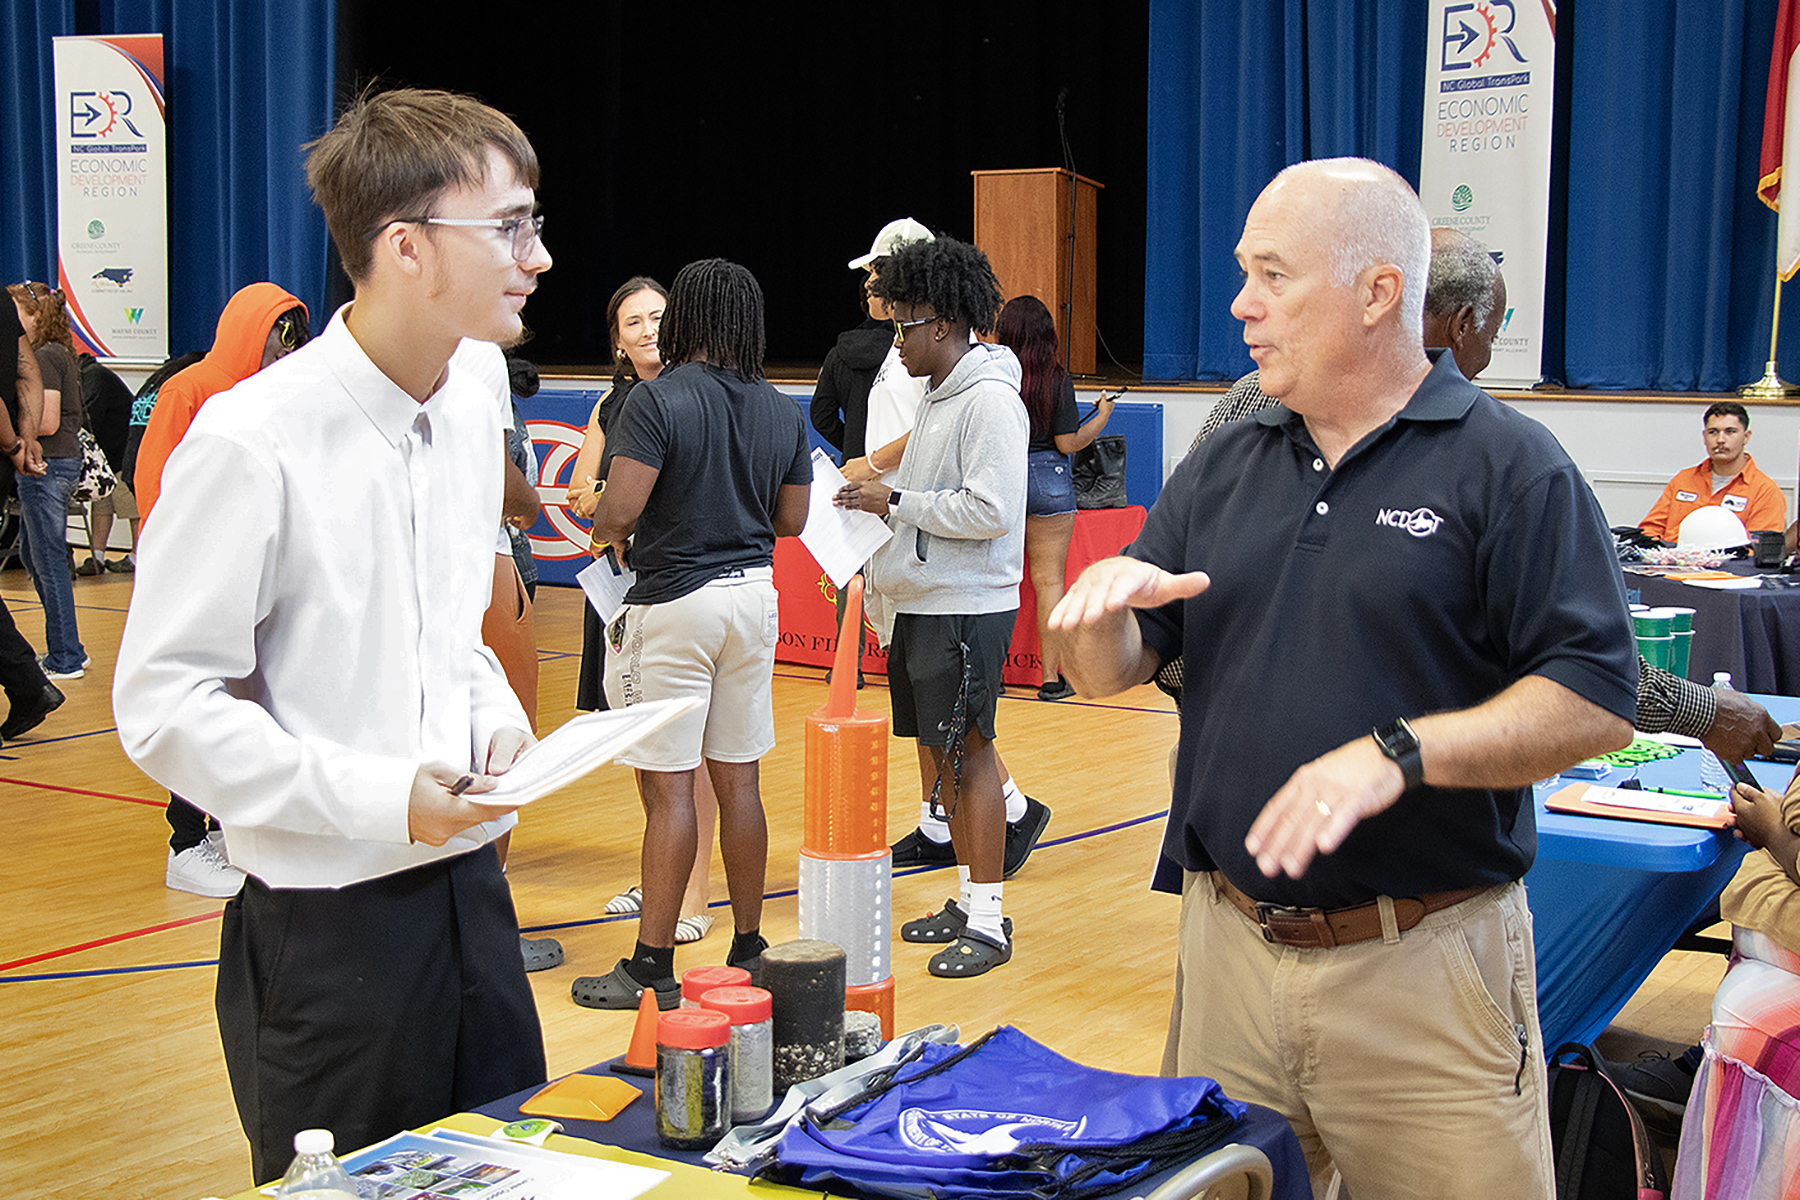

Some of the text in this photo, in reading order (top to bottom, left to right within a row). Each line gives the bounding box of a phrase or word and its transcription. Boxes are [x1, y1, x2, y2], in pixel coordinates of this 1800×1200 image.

[1443, 73, 1529, 92] NC Global TransPark
[1438, 93, 1529, 121] ECONOMIC
[1437, 116, 1528, 138] DEVELOPMENT
[1449, 135, 1516, 152] REGION
[70, 158, 147, 174] ECONOMIC
[70, 174, 147, 186] DEVELOPMENT
[83, 186, 138, 197] REGION
[1431, 215, 1491, 226] GREENE COUNTY
[1498, 337, 1530, 346] COUNTY
[942, 1112, 990, 1121] STATE
[994, 1112, 1018, 1120] OF
